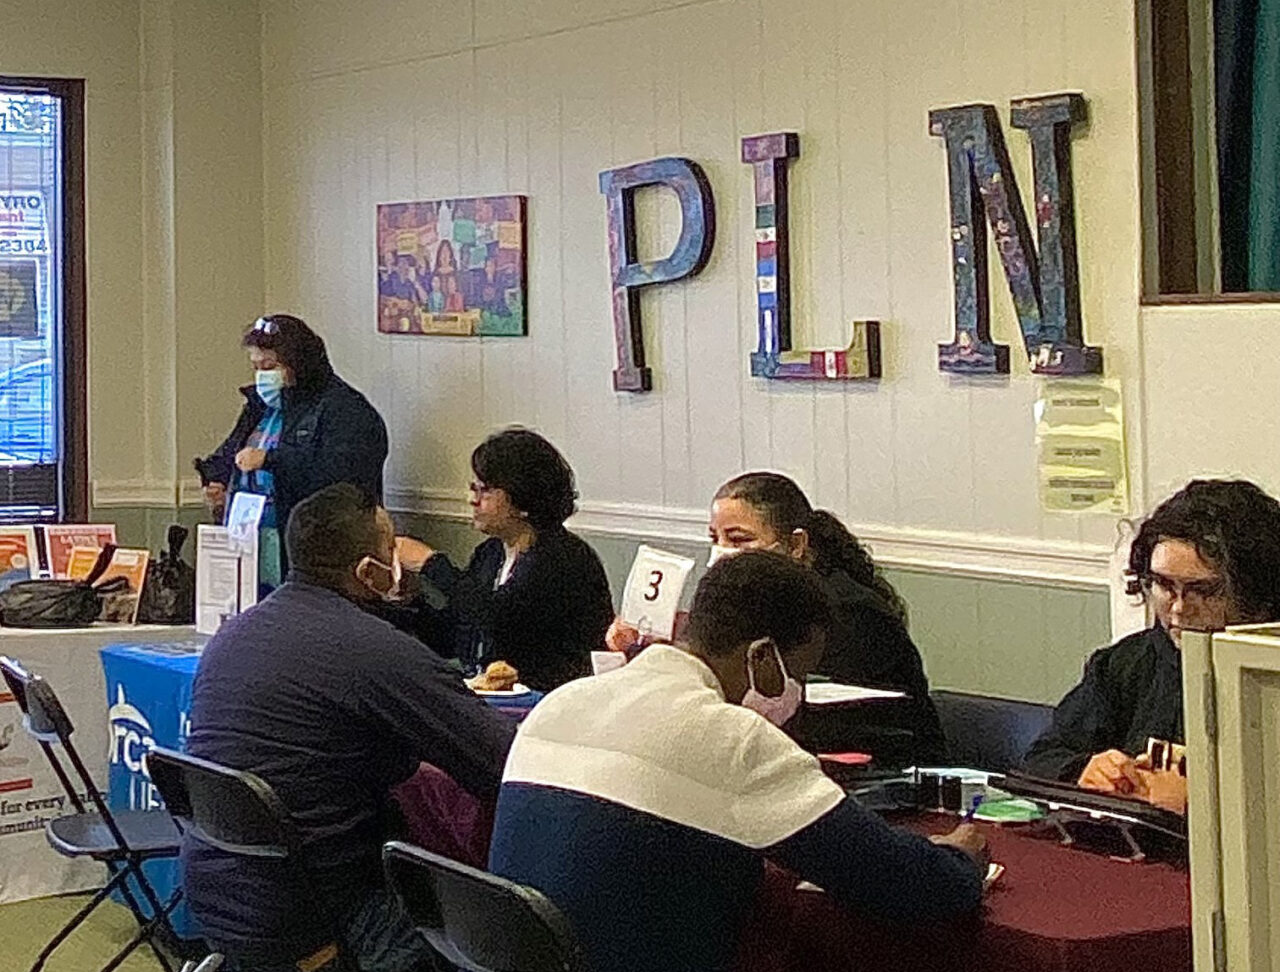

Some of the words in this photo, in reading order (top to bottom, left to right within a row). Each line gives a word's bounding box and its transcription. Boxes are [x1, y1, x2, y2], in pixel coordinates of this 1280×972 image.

[644, 570, 663, 601] 3
[1, 799, 22, 816] for
[25, 794, 66, 812] every
